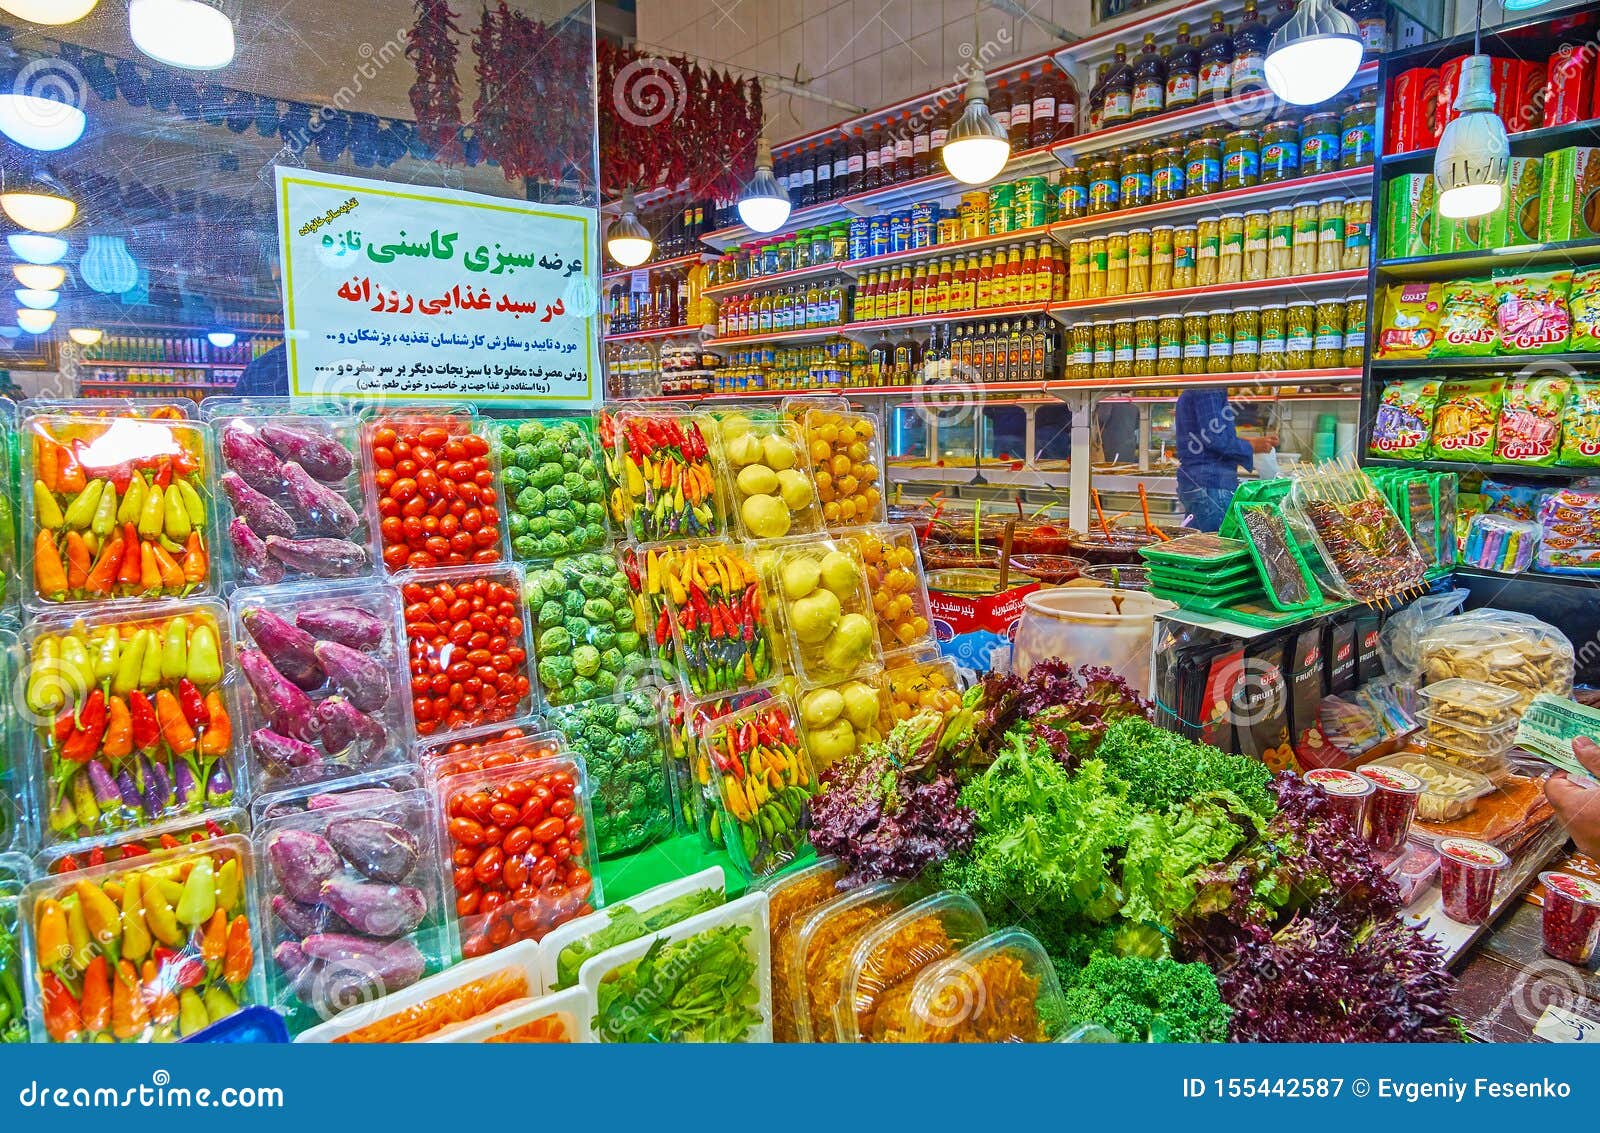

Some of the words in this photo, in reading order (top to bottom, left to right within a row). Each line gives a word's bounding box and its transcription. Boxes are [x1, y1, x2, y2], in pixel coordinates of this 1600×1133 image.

[299, 216, 325, 236] خانواده
[321, 230, 361, 257] تازه
[366, 229, 459, 264] کاسنی
[463, 243, 535, 275] سبزی
[538, 253, 582, 277] عرضه
[337, 275, 414, 314] روزانه
[418, 284, 492, 315] غذایی
[495, 294, 537, 319] سبد
[540, 297, 566, 323] در
[338, 332, 346, 344] و
[347, 328, 391, 347] پزشکان
[431, 333, 485, 348] کارشناسان
[487, 335, 523, 350] سفارش
[1447, 328, 1495, 345] گلین
[1516, 324, 1569, 348] گلین
[531, 337, 553, 352] تایید
[554, 341, 578, 354] مورد
[345, 360, 375, 377] سفره
[377, 367, 393, 377] سر
[394, 364, 406, 377] بر
[407, 361, 434, 377] دیگر
[435, 362, 482, 379] سبزیجات
[483, 363, 492, 379] با
[493, 363, 527, 379] مخلوط
[563, 366, 588, 382] روش
[381, 379, 400, 391] طعم
[400, 380, 423, 391] خوش
[430, 380, 458, 391] خاصیت
[467, 381, 486, 391] جهت
[487, 381, 500, 390] غذا
[500, 383, 510, 392] در
[510, 382, 536, 391] استفاده
[1378, 433, 1422, 452] گلین
[1441, 430, 1490, 450] گلین
[1502, 440, 1553, 459] گلین
[940, 601, 961, 613] سفید
[961, 603, 975, 619] پنیر
[1359, 650, 1375, 663] FRUIT
[1295, 669, 1314, 684] FRUIT
[1251, 687, 1275, 704] FRUIT
